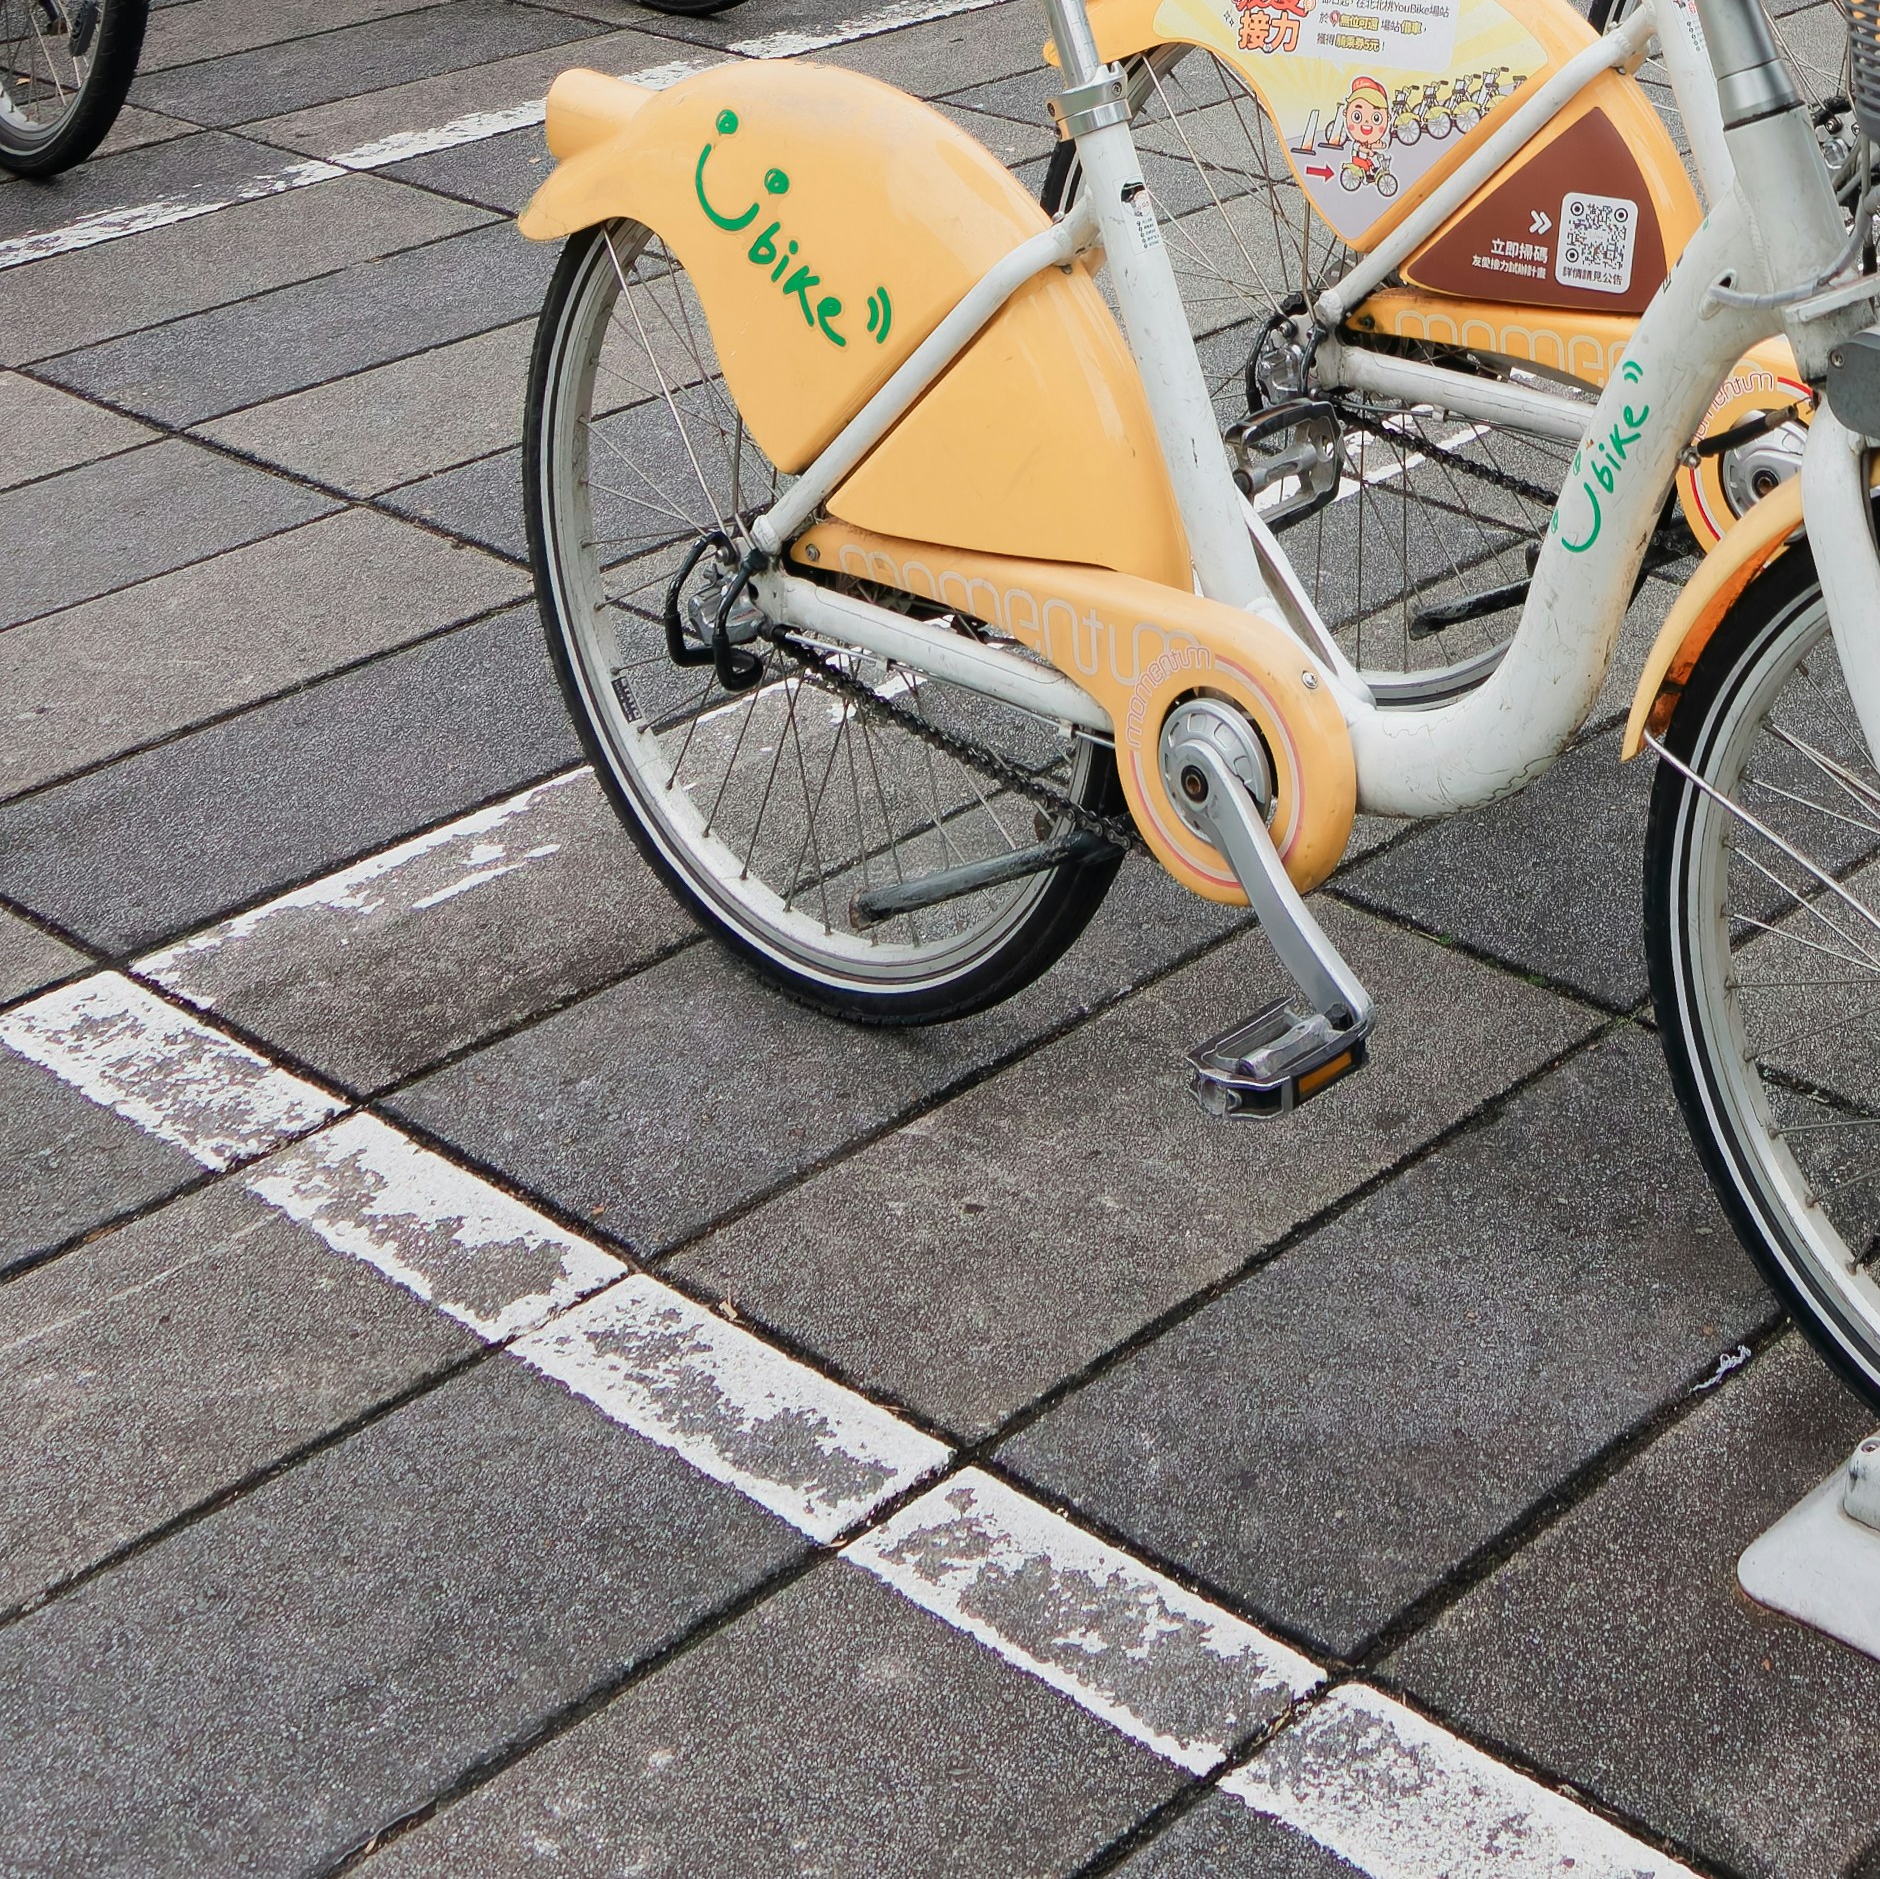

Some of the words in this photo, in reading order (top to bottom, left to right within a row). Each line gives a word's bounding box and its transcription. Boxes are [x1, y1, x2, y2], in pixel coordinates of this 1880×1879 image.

[1238, 10, 1301, 53] 接力
[1491, 238, 1550, 264] 立即掃碼
[1471, 255, 1547, 280] 友愛接力試辦計畫
[1562, 264, 1624, 287] 詳情請見公告
[839, 543, 1203, 688] momentum
